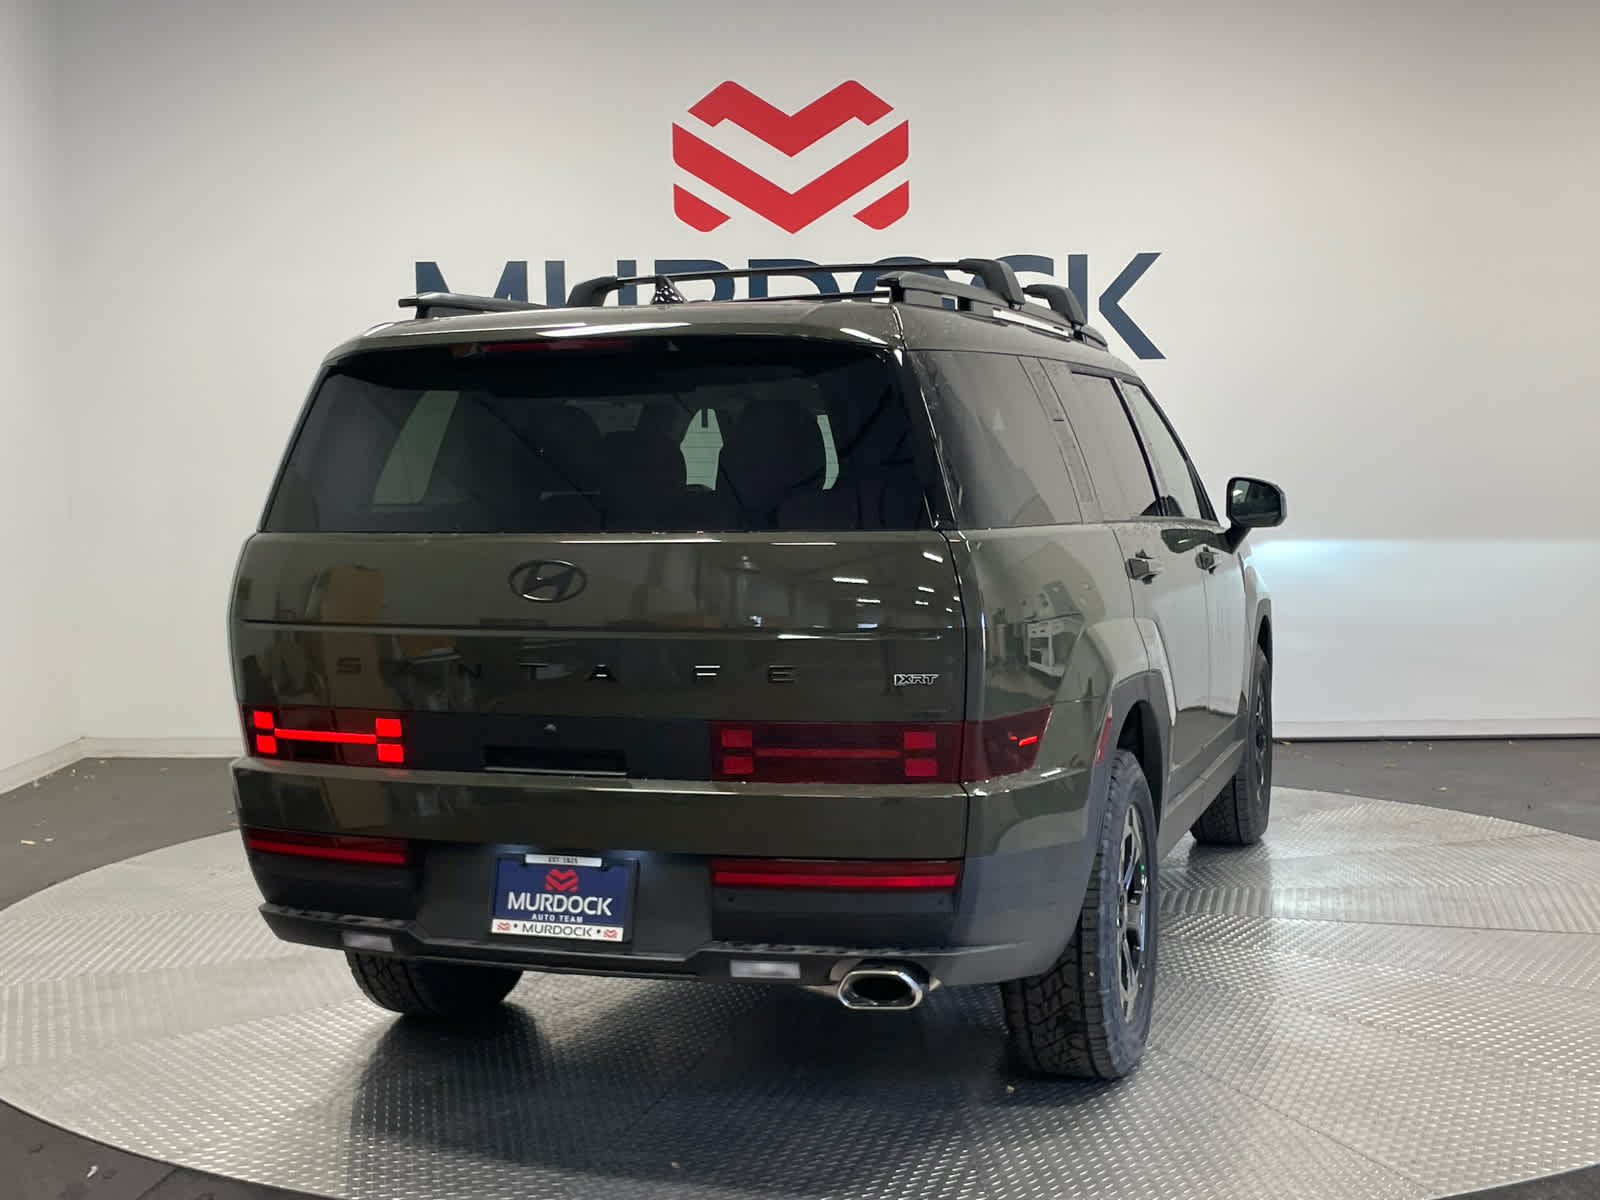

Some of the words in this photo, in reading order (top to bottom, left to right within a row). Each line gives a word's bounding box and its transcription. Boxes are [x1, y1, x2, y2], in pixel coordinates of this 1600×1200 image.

[895, 673, 939, 687] XRT
[507, 891, 613, 916] MURDOCK
[531, 913, 556, 922] AUTO
[559, 915, 584, 923] TEAM
[522, 922, 592, 937] MURDOCK
